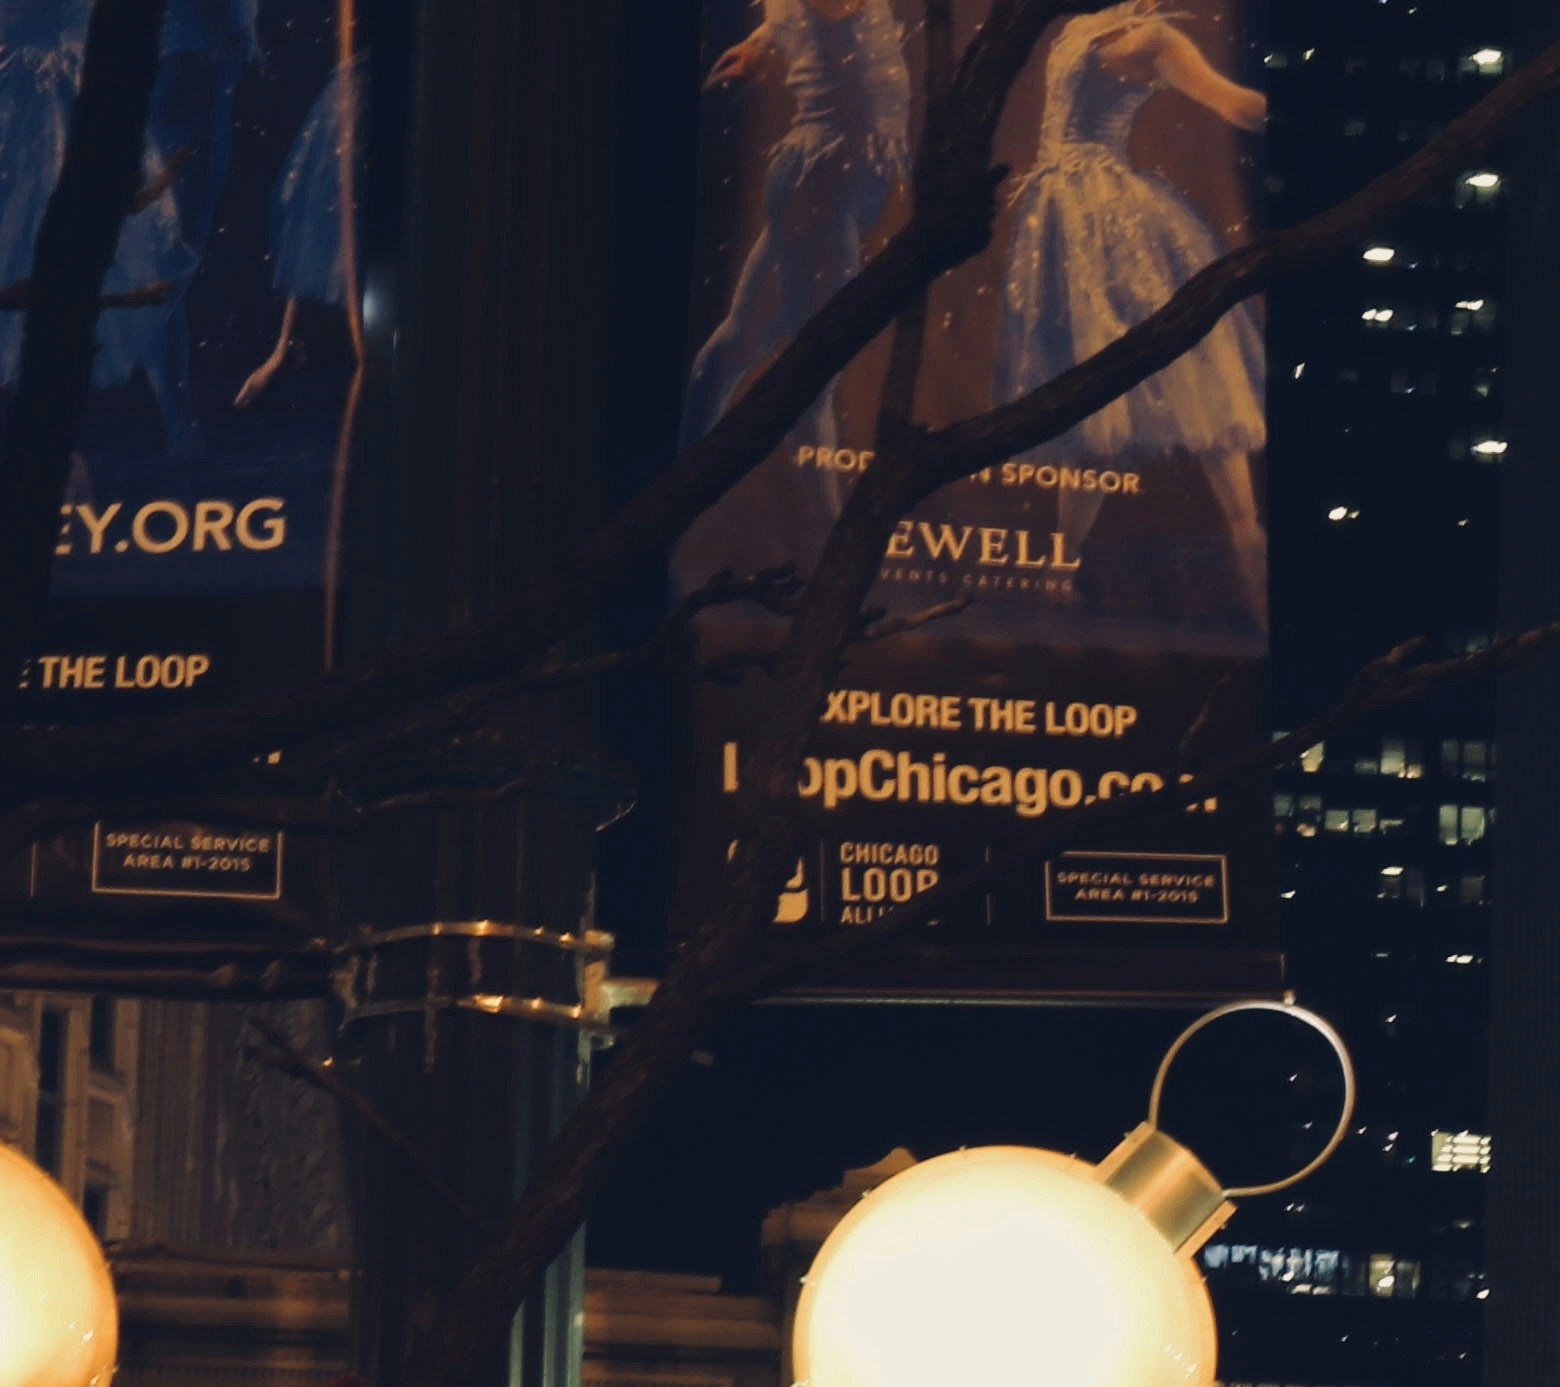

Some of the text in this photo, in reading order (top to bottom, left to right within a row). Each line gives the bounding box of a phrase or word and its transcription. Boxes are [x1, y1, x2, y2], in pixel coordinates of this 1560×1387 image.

[1001, 464, 1141, 495] SPONSOR
[886, 519, 1081, 571] EWELL
[881, 568, 1074, 594] VENTS CATERING
[38, 656, 107, 689] THE
[115, 654, 210, 689] LOOP
[821, 690, 1139, 738] XPLORE THE LOOP
[105, 833, 271, 853] SPECIAL SERVICE
[840, 841, 940, 867] CHICAGO
[123, 854, 174, 869] AREA
[841, 868, 939, 903] LOOP
[1057, 871, 1217, 889] SPECIAL SERVICE
[1075, 888, 1125, 902] AREA
